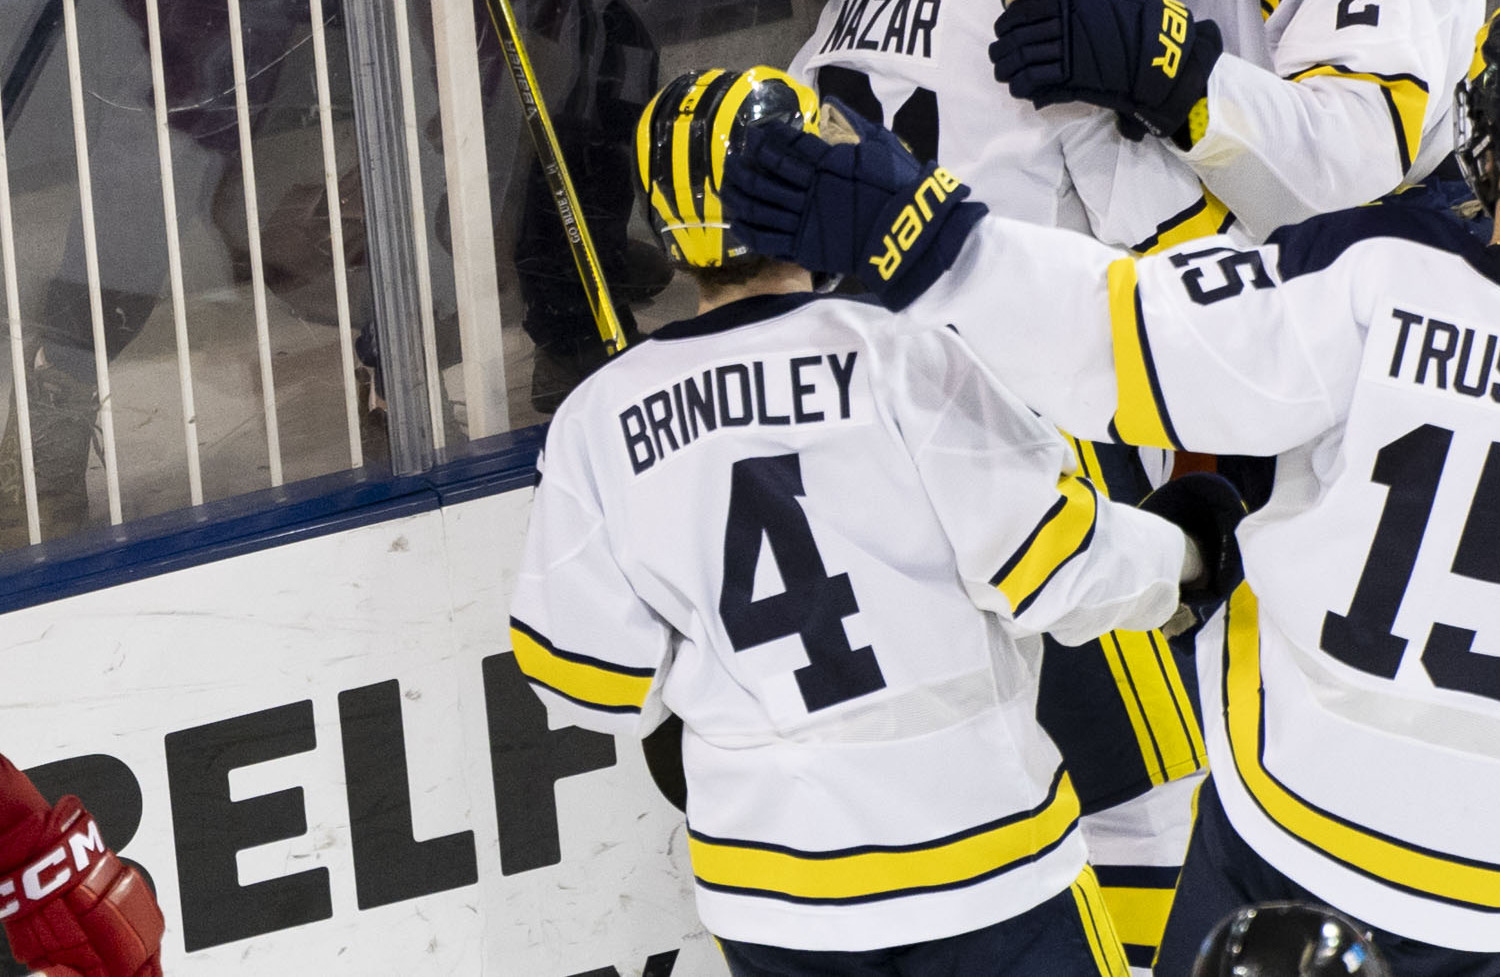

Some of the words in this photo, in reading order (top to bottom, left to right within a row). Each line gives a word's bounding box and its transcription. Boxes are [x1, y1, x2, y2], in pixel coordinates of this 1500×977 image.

[558, 197, 576, 226] BLUE
[568, 226, 581, 244] GO
[618, 351, 858, 476] BRINDLEY
[719, 452, 887, 714] 4
